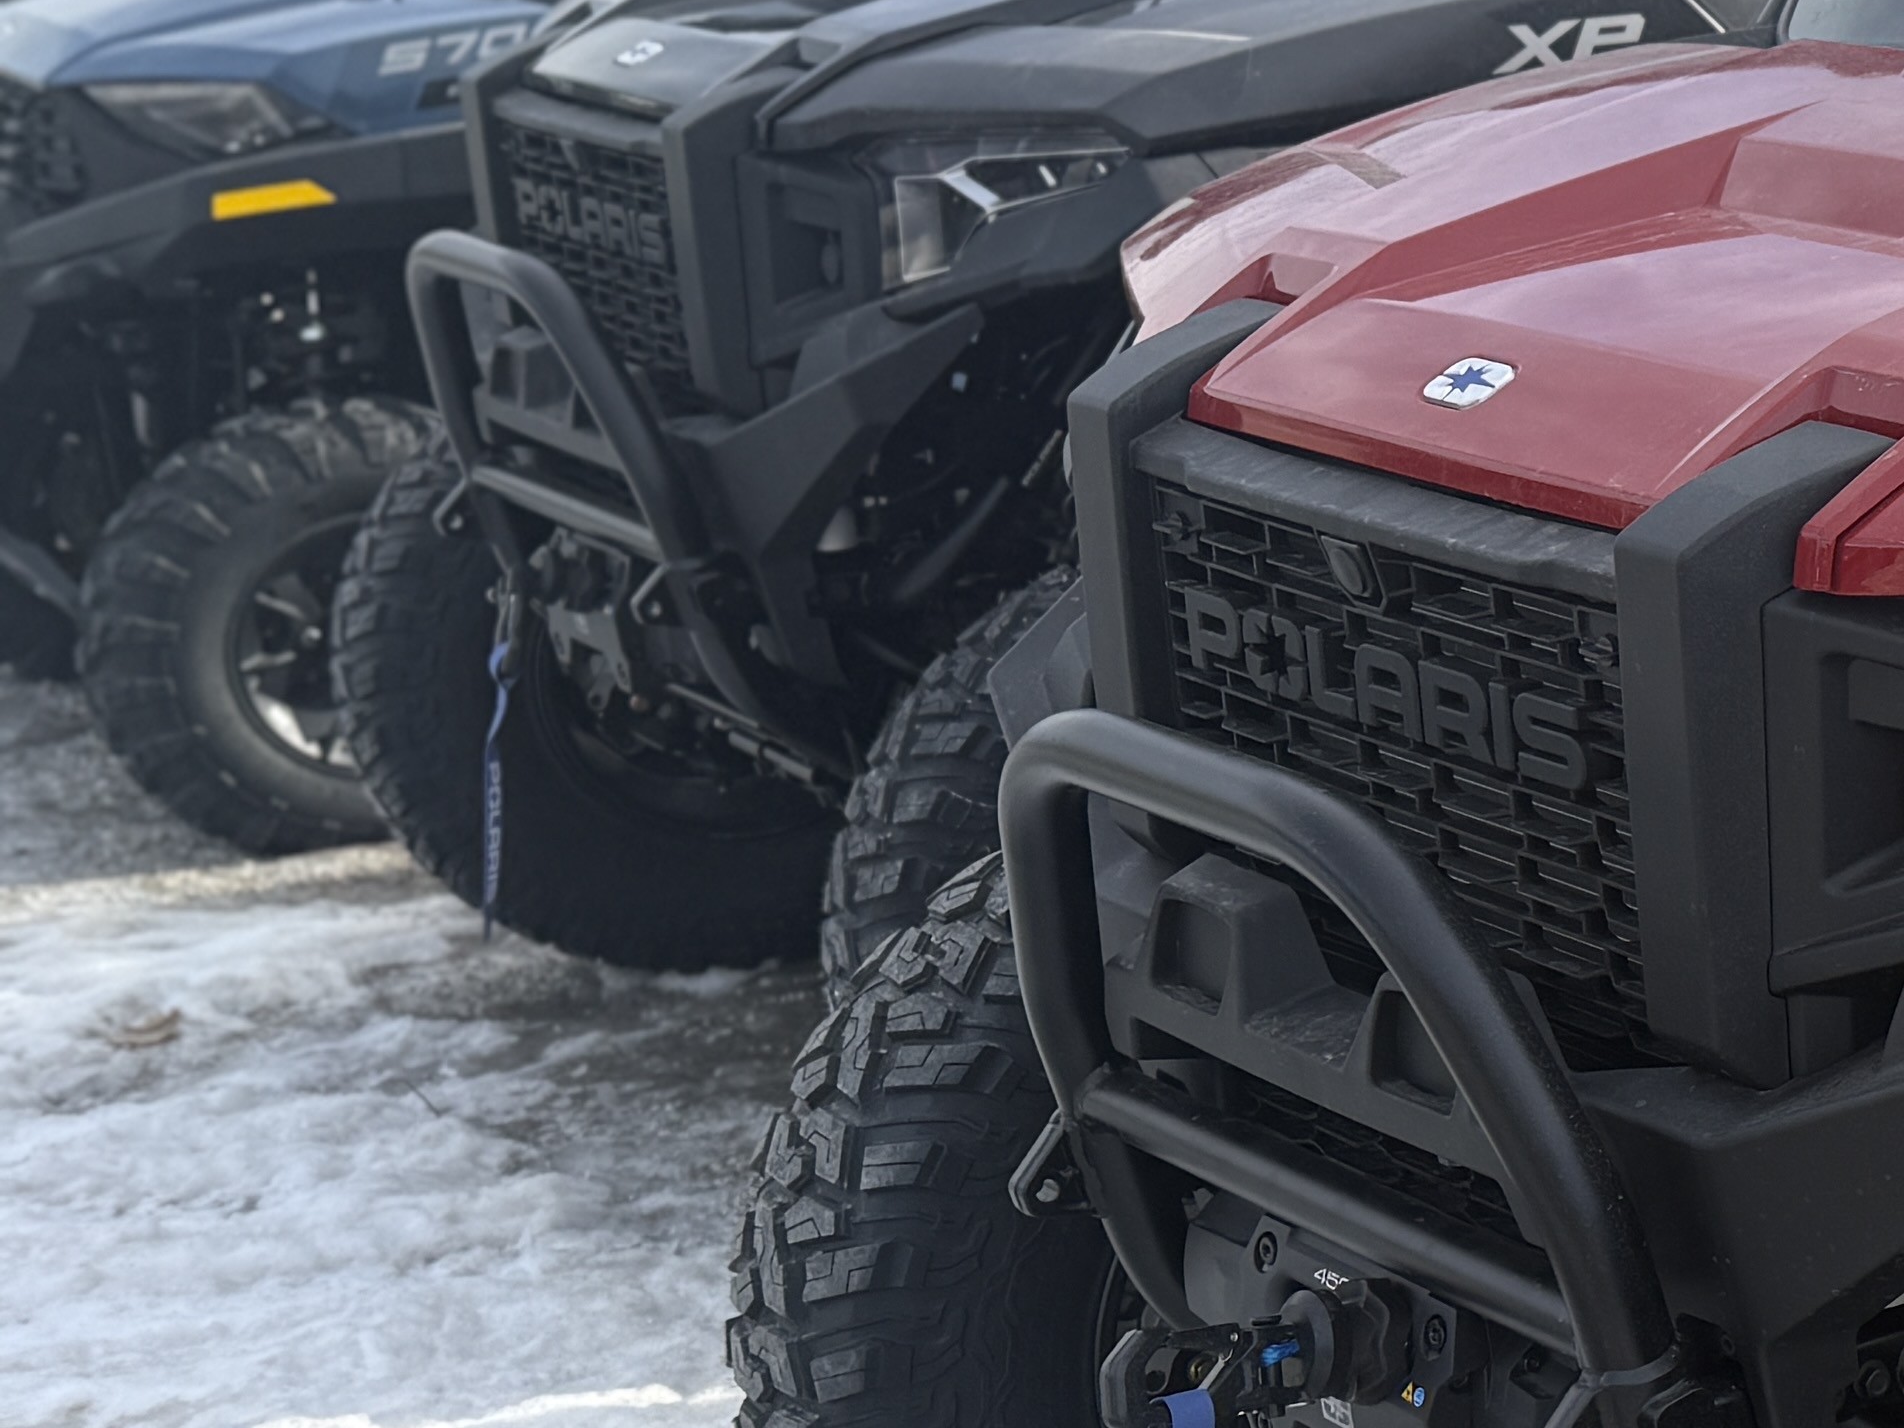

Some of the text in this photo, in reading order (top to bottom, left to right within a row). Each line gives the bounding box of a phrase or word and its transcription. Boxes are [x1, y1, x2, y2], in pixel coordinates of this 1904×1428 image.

[1492, 13, 1646, 75] XP
[510, 176, 668, 264] POLARIS
[1182, 585, 1590, 790] POLARIS
[488, 760, 502, 902] POLARI
